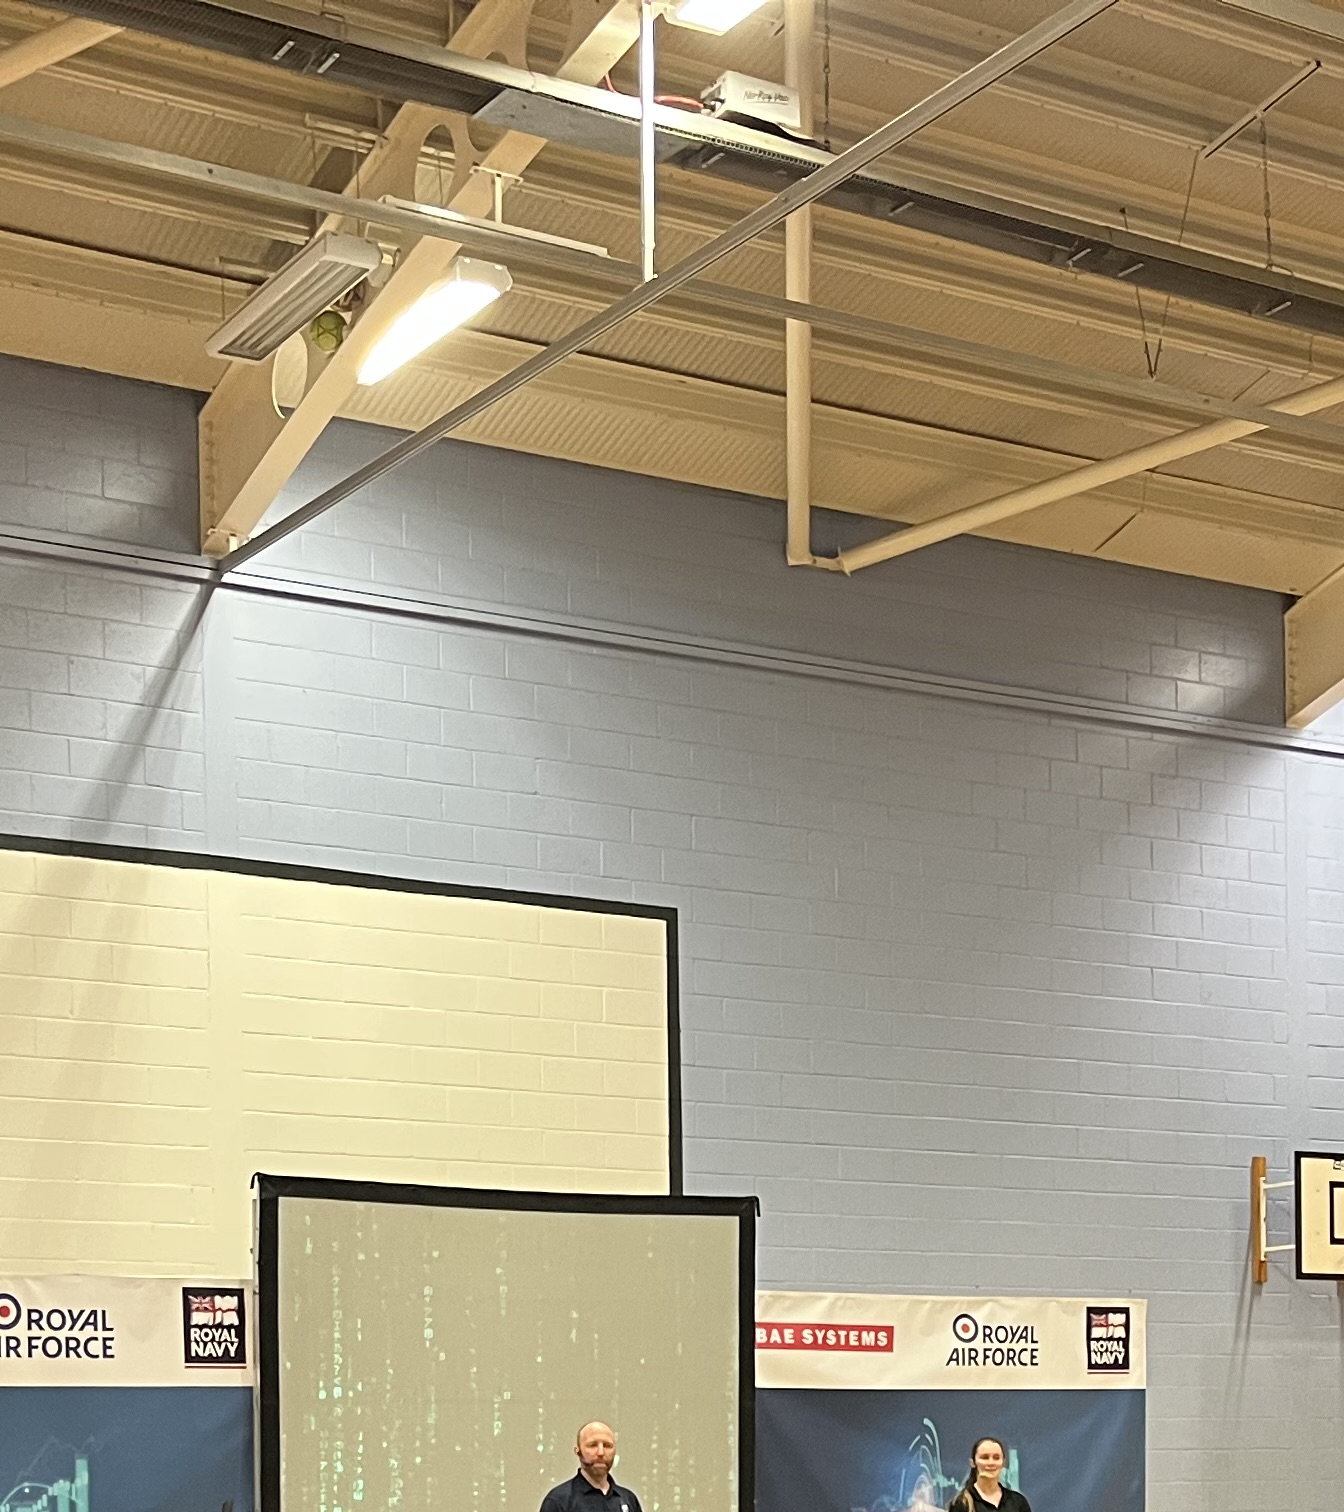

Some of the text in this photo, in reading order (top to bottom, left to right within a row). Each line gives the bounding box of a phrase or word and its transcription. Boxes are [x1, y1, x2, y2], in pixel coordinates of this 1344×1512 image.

[26, 1308, 115, 1331] ROYAL
[190, 1327, 239, 1342] ROYAL
[755, 1327, 888, 1347] BAE SYSTEMS
[982, 1325, 1039, 1344] ROYAL
[27, 1335, 115, 1359] FORCE
[190, 1341, 239, 1358] NAVY
[1090, 1340, 1125, 1352] ROYAL
[946, 1347, 1039, 1366] AIR FORCE
[1090, 1351, 1125, 1365] NAVY
